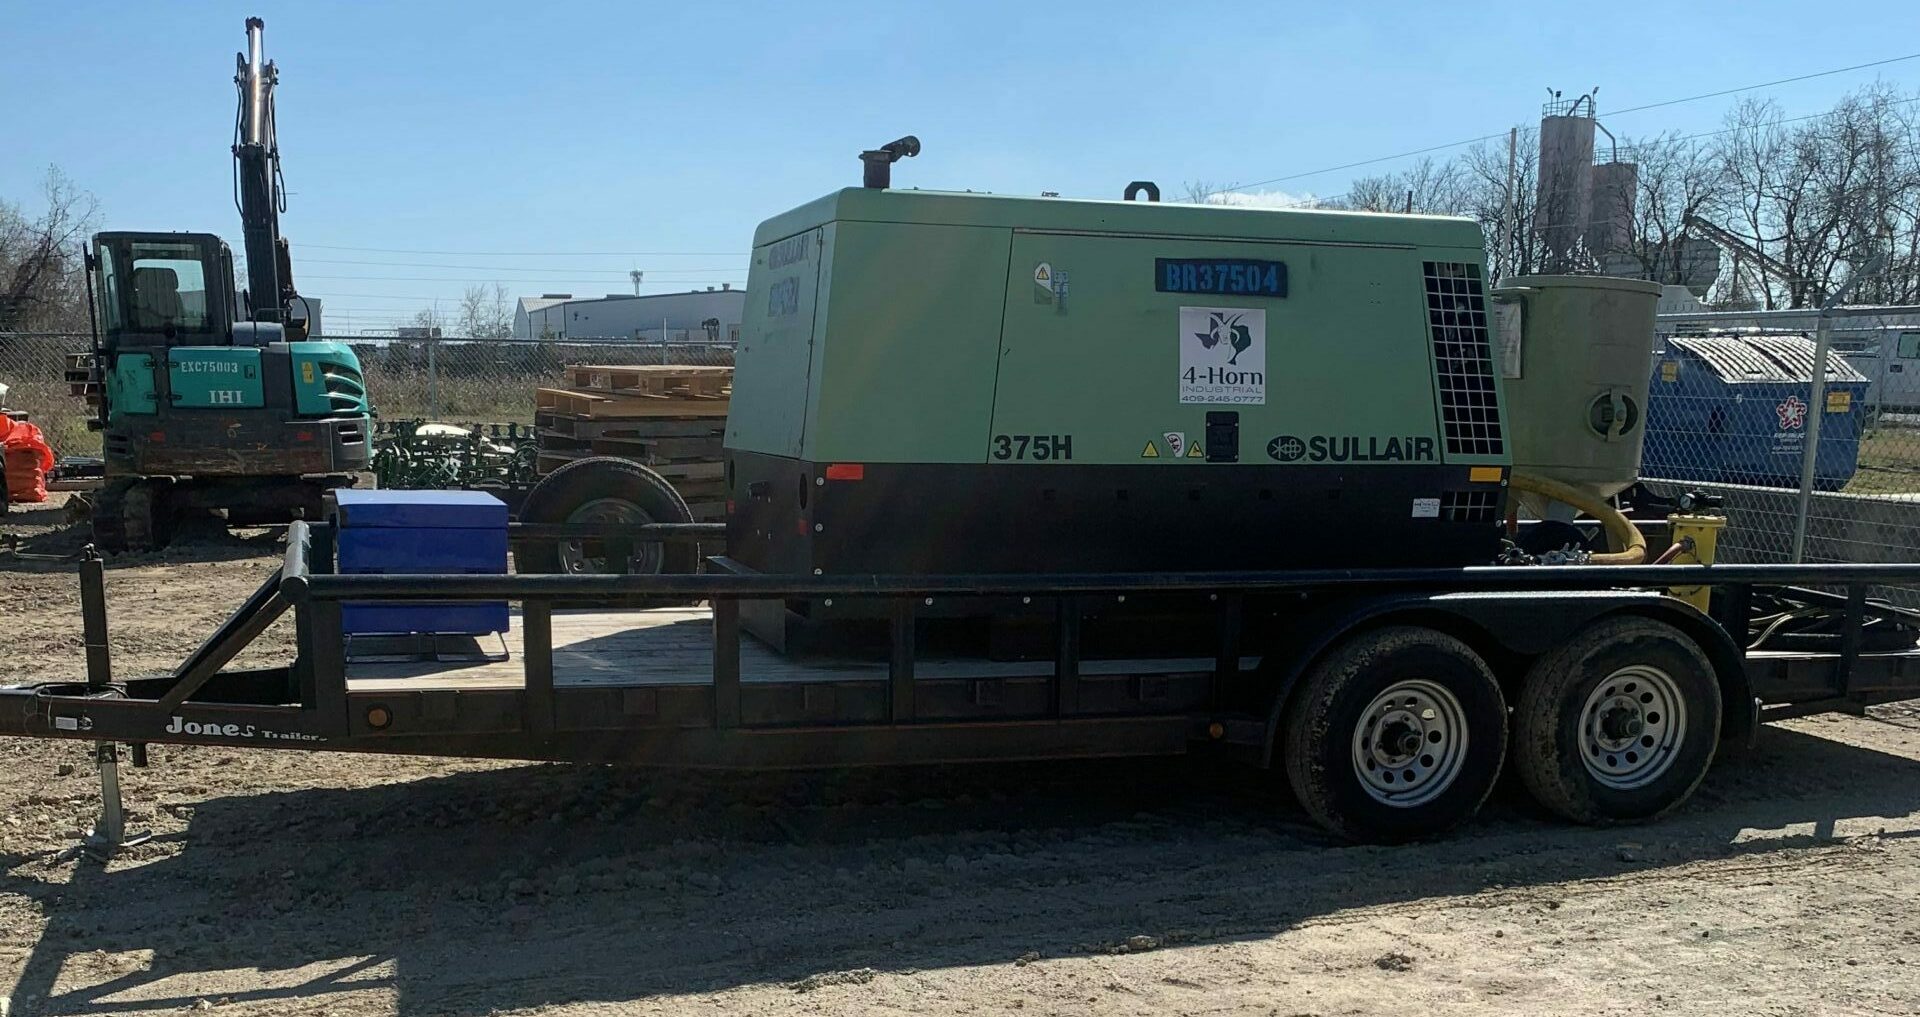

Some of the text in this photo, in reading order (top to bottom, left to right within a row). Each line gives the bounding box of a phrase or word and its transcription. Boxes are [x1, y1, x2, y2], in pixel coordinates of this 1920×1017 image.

[1166, 263, 1278, 292] BR37504
[181, 361, 238, 373] EXC75003
[1182, 366, 1263, 385] 4-Horn
[208, 390, 244, 404] IHI
[1182, 385, 1262, 394] INDUSTRIAL
[993, 435, 1072, 460] 375H
[166, 716, 255, 737] Jones
